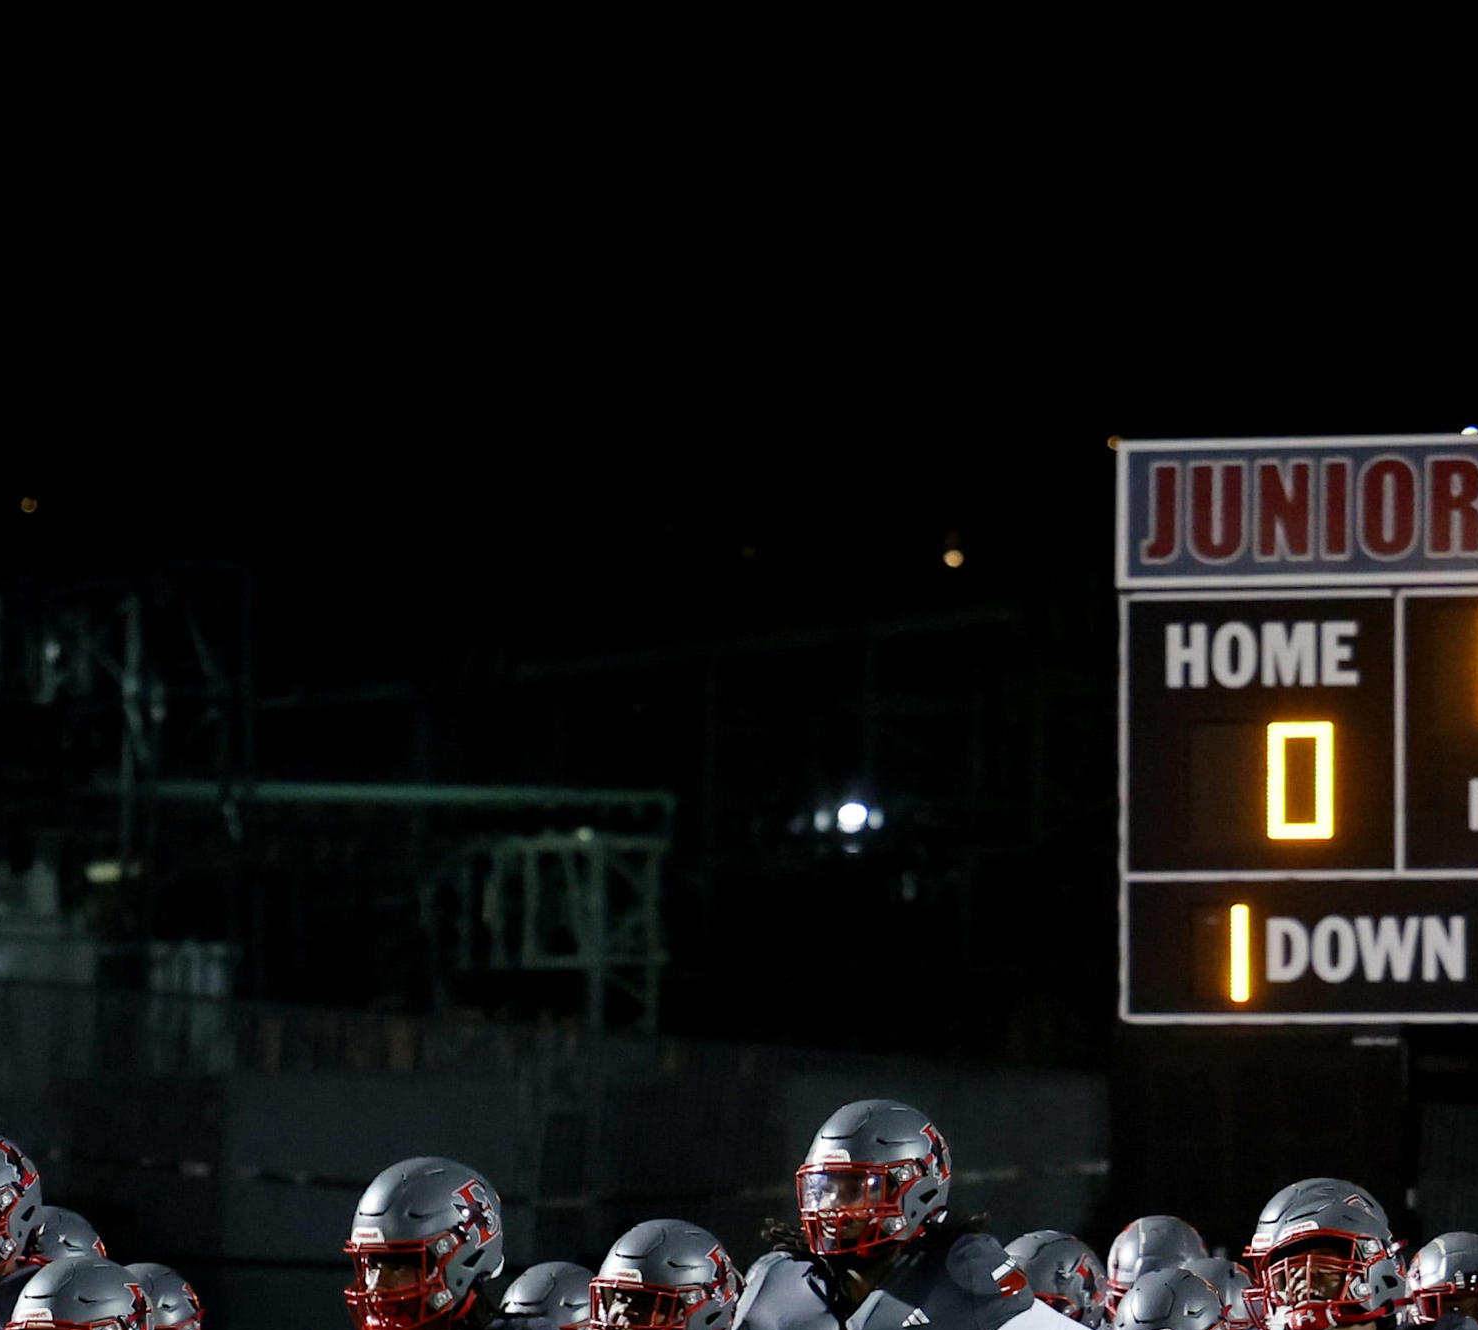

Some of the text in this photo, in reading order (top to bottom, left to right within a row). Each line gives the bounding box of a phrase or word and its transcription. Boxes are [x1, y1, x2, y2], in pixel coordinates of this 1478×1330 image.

[1165, 621, 1359, 689] HOME
[1266, 720, 1335, 841] 0
[1229, 903, 1251, 1003] 1
[1265, 916, 1468, 983] DOWN
